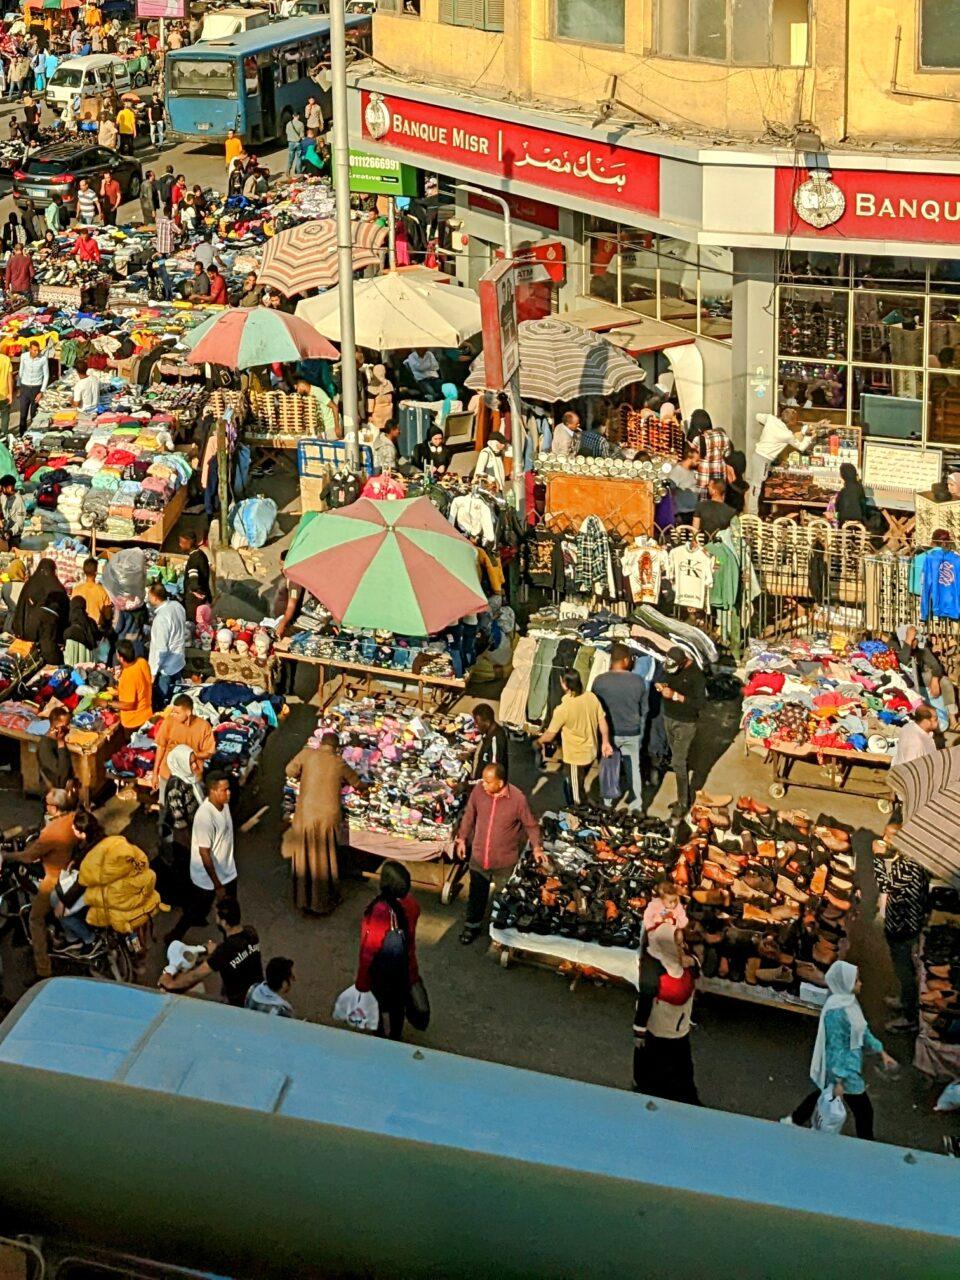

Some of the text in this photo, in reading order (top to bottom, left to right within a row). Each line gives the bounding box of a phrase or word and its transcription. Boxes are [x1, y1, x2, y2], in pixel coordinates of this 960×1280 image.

[393, 114, 489, 155] BANQUE MISR
[514, 141, 627, 192] بنك مصر
[517, 267, 533, 279] ATM
